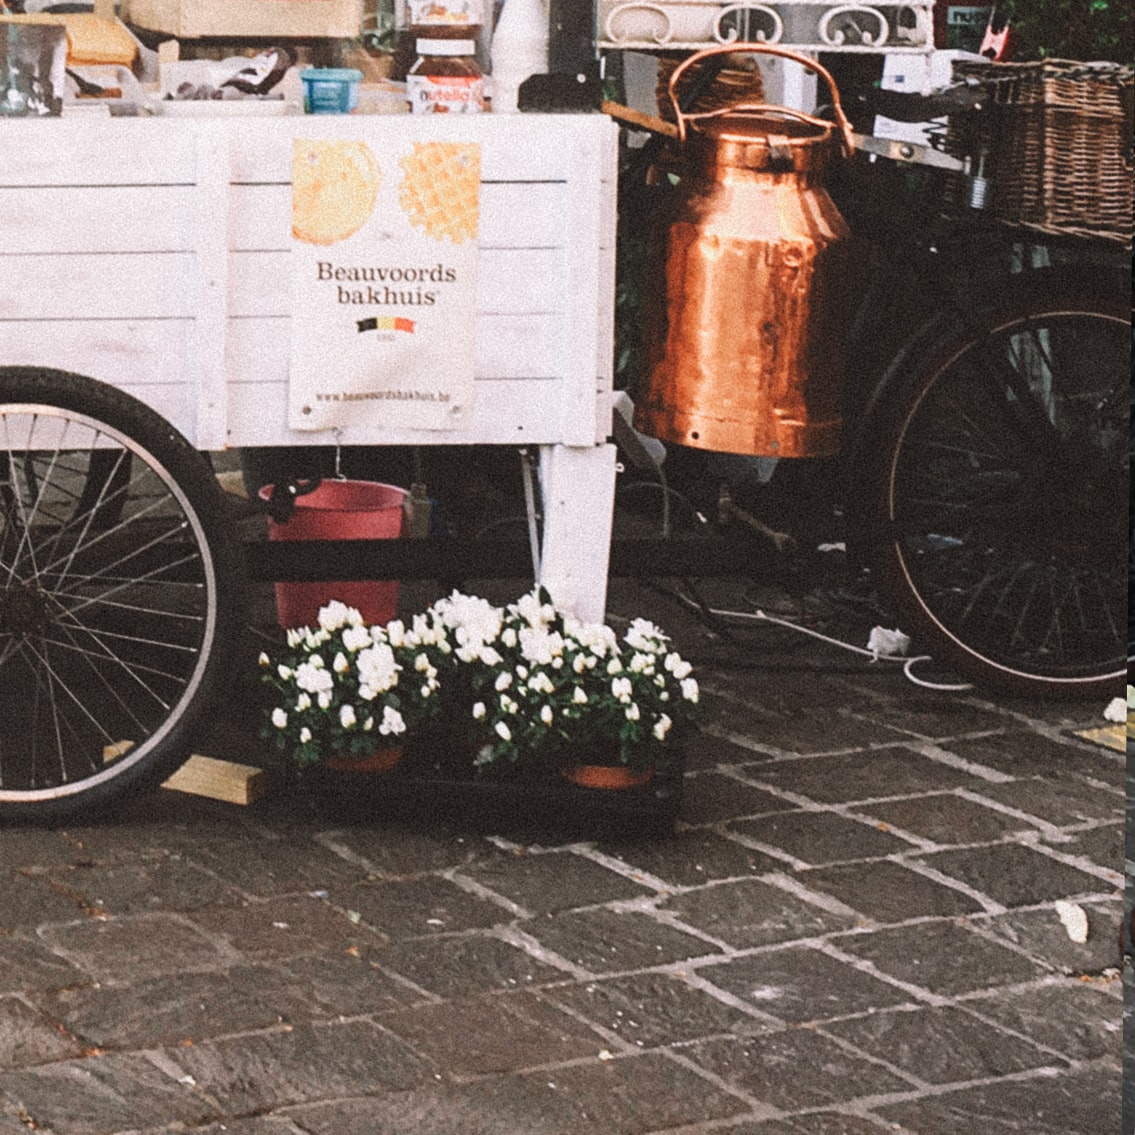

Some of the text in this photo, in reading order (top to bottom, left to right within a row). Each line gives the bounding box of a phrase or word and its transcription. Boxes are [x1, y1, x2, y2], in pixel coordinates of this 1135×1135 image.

[420, 86, 470, 104] nutella
[316, 261, 457, 283] Beauvoords
[337, 285, 437, 307] bakhuis
